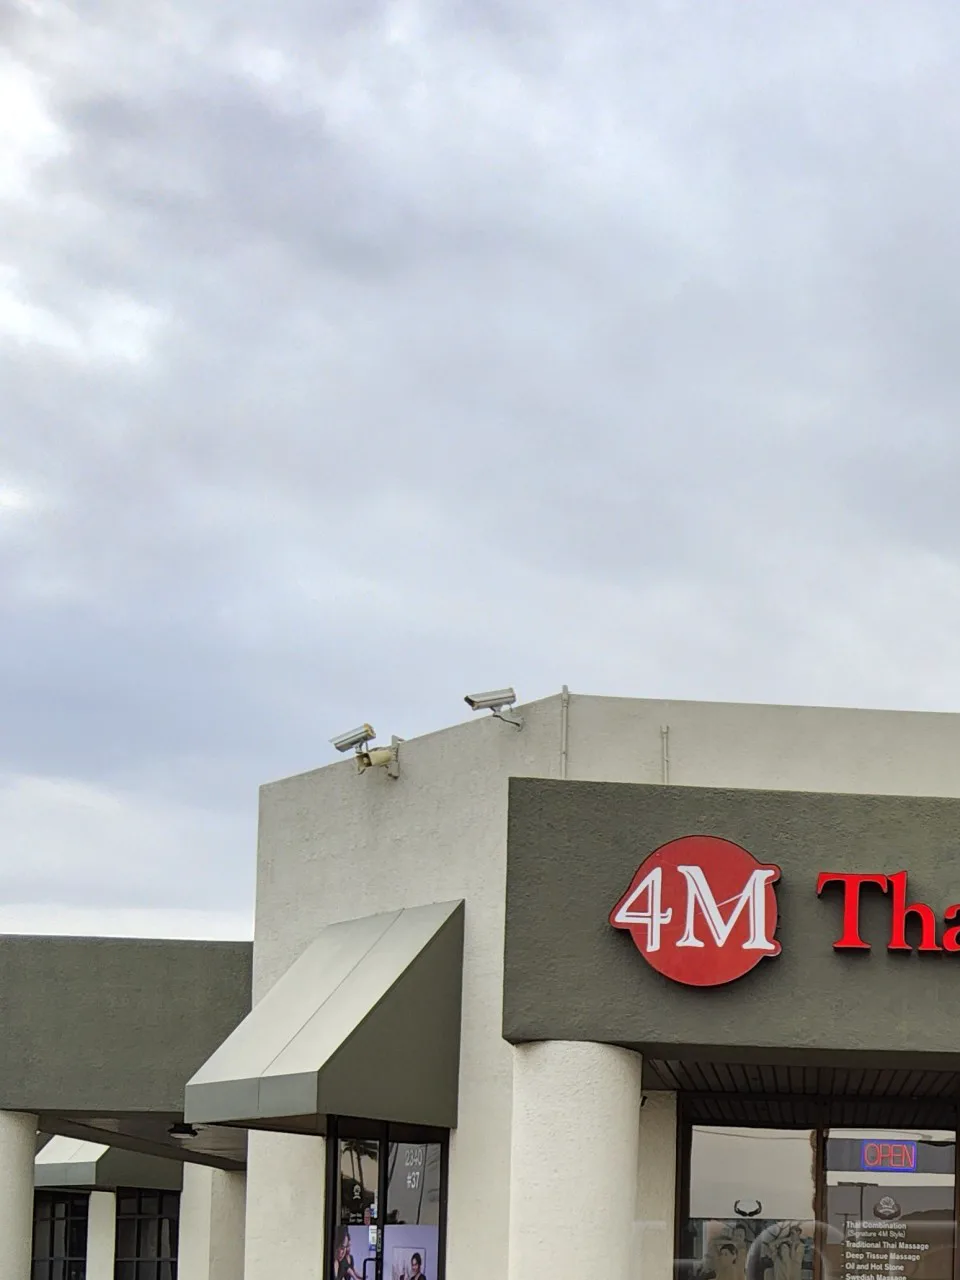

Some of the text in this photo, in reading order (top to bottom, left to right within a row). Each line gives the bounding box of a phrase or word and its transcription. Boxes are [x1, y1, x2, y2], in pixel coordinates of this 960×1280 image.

[613, 863, 777, 952] 4M
[864, 1143, 915, 1168] OPEN
[406, 1171, 420, 1188] #37
[846, 1221, 907, 1229] Thai Combination
[846, 1241, 929, 1252] Traditional Thai Massage
[845, 1252, 921, 1262] Deep Tissue Massage
[845, 1262, 855, 1270] Oil
[856, 1262, 869, 1270] and
[884, 1263, 904, 1271] Stone
[845, 1273, 875, 1280] Swedish
